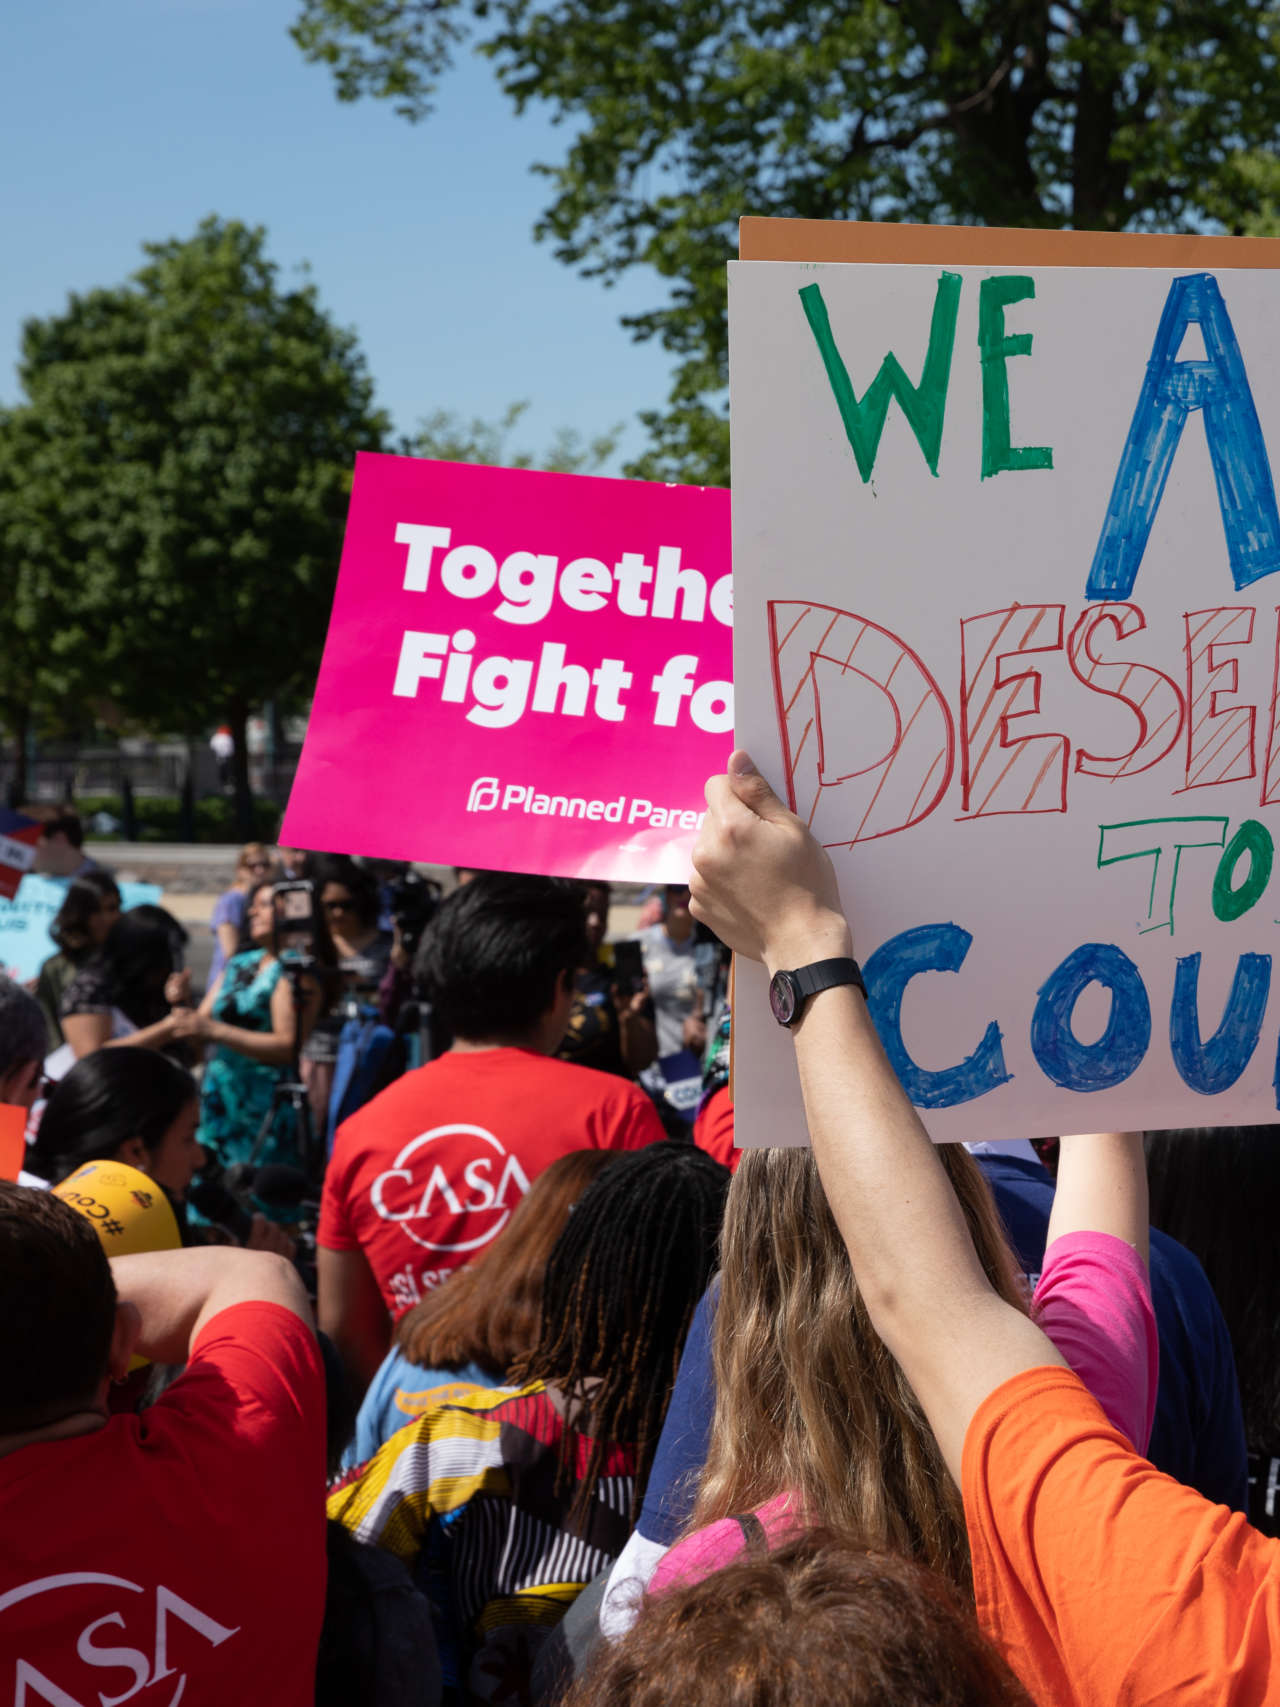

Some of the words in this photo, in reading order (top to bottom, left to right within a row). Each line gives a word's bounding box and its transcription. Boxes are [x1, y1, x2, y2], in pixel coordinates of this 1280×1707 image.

[799, 271, 1055, 483] WE
[393, 628, 633, 729] Fight
[651, 654, 735, 734] fo
[502, 785, 626, 823] Planned
[1097, 815, 1275, 936] TO
[370, 1153, 532, 1221] CASA
